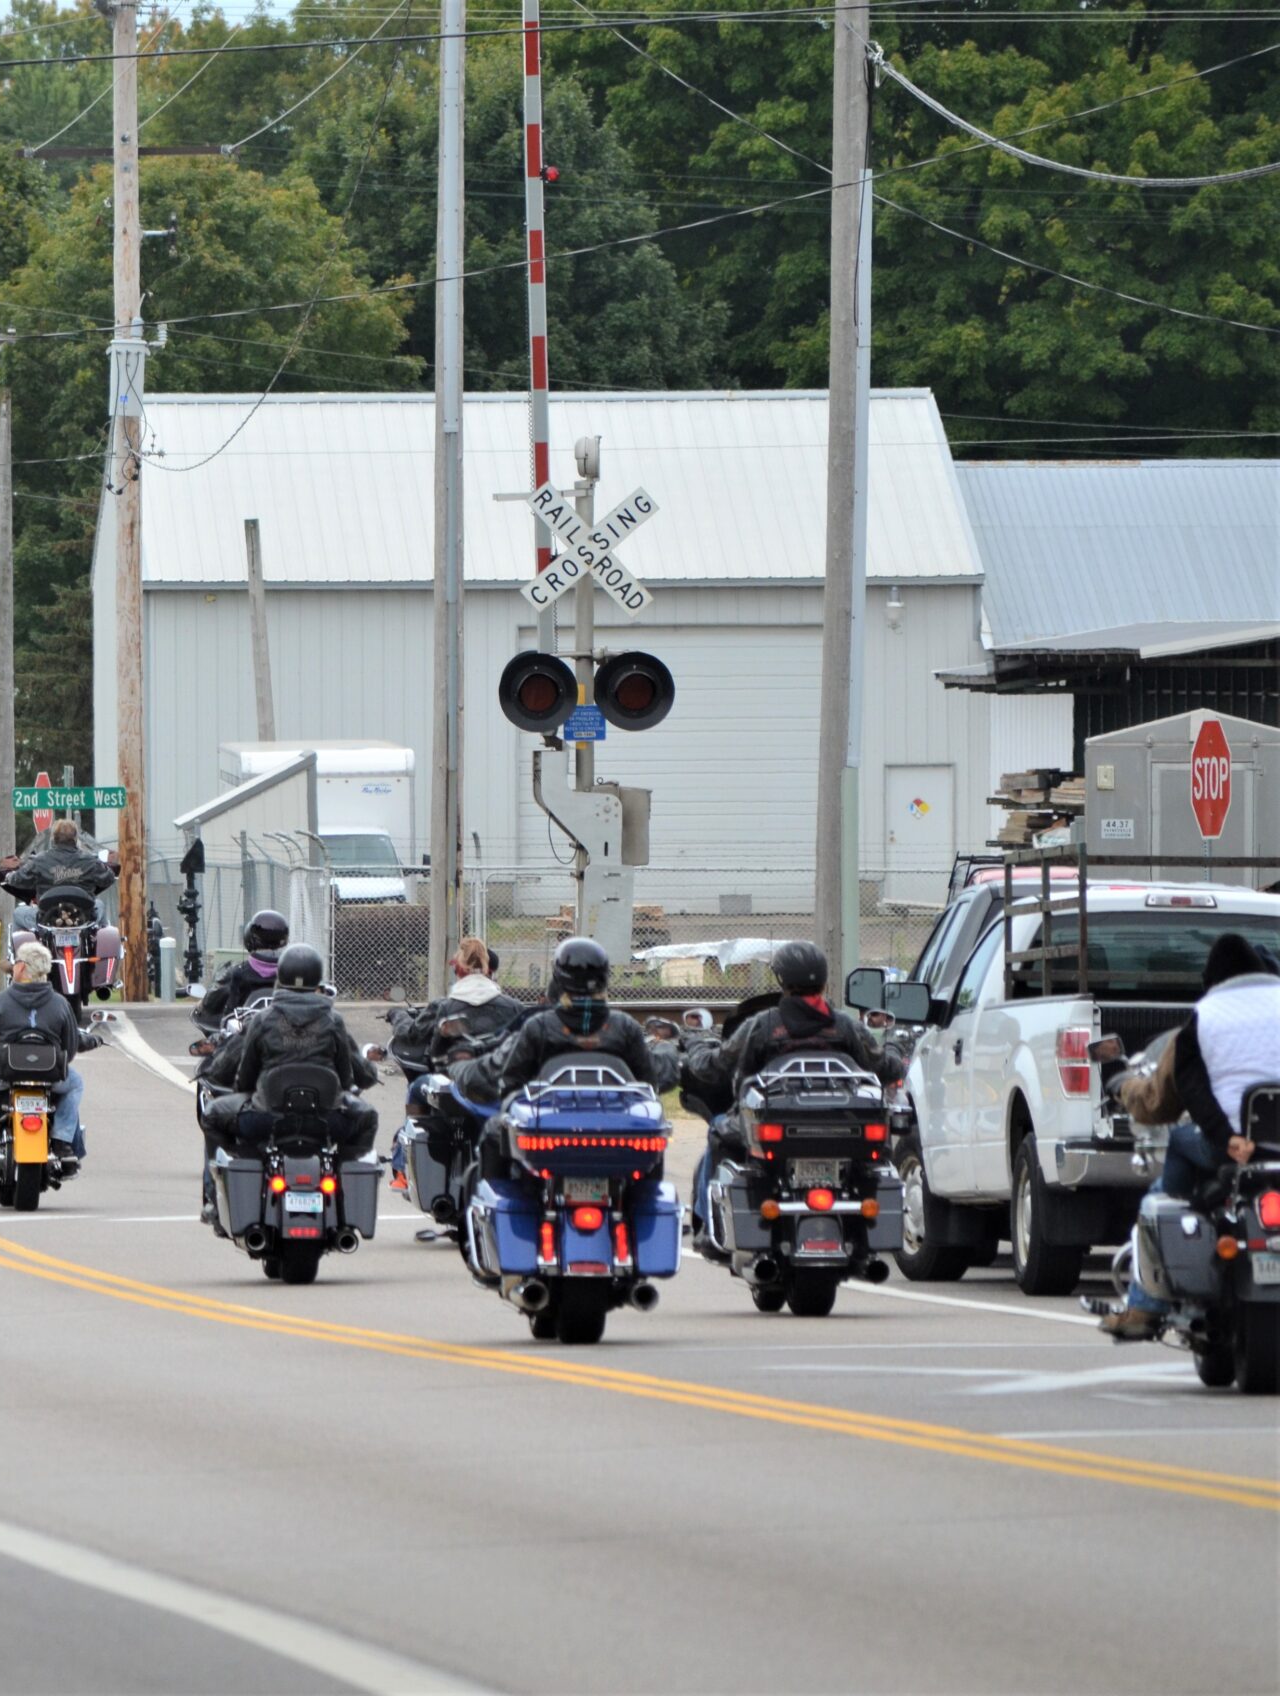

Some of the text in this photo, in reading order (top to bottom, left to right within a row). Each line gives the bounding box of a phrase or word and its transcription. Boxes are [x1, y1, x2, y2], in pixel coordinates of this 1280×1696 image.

[531, 495, 653, 605] CROSSING
[15, 790, 123, 807] 2nd Street West
[1193, 756, 1229, 800] STOP
